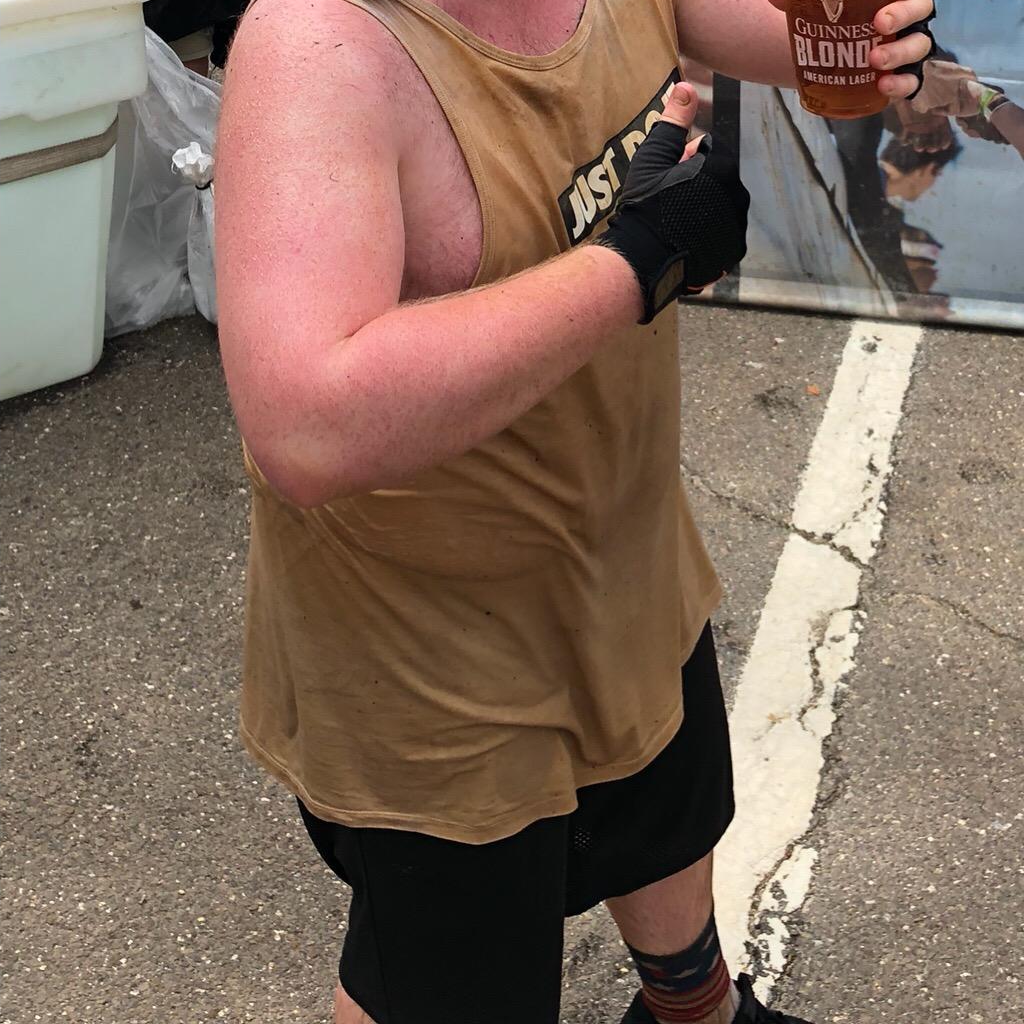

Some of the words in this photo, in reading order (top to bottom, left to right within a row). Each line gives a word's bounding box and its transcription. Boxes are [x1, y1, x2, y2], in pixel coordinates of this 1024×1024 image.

[803, 70, 846, 85] AMERICAN
[849, 71, 876, 85] LAGER
[568, 146, 621, 239] JUST
